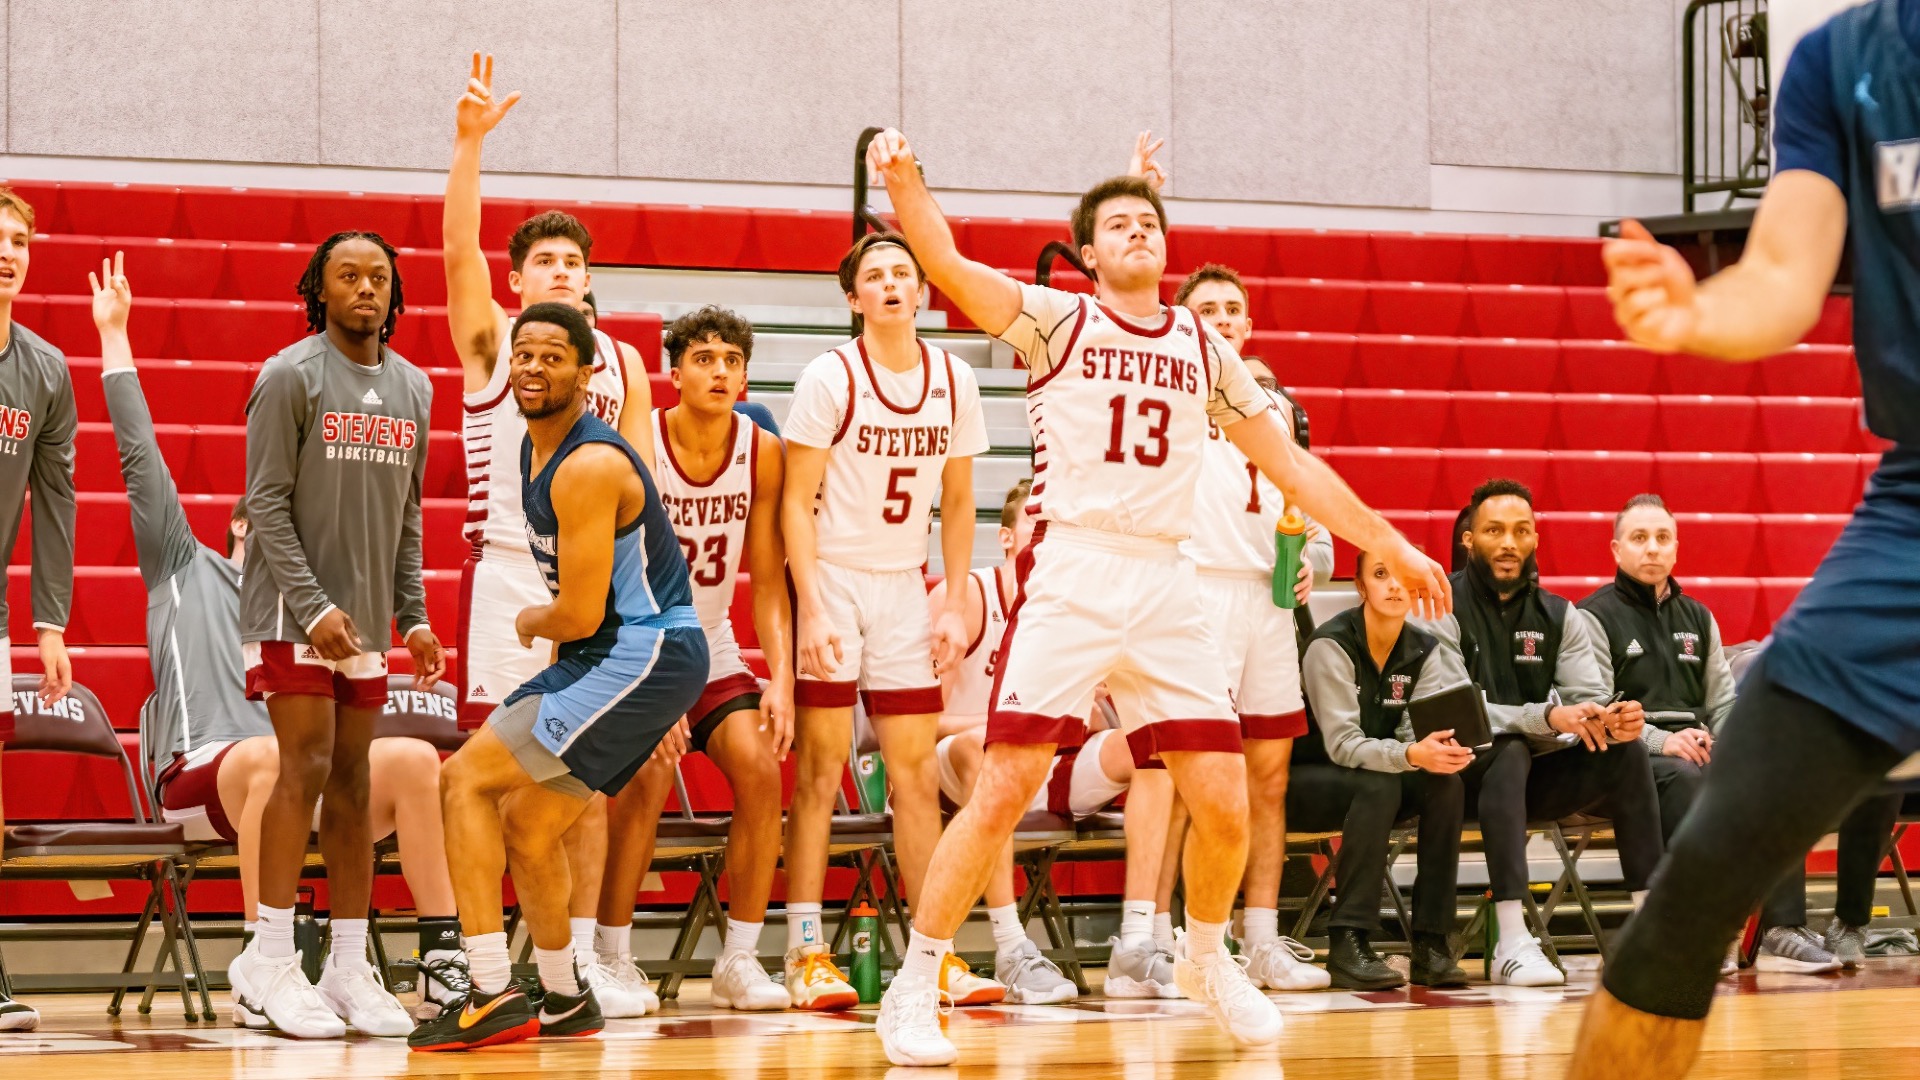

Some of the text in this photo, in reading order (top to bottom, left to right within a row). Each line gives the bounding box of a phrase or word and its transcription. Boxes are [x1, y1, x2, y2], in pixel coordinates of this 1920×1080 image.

[1082, 347, 1198, 395] STEVENS
[323, 412, 417, 450] STEVENS
[857, 424, 949, 457] STEVENS
[1104, 393, 1171, 468] 13
[326, 445, 408, 466] BASKETBALL
[661, 491, 748, 527] STEVENS
[882, 467, 917, 525] 5
[1515, 631, 1545, 641] STEVENS
